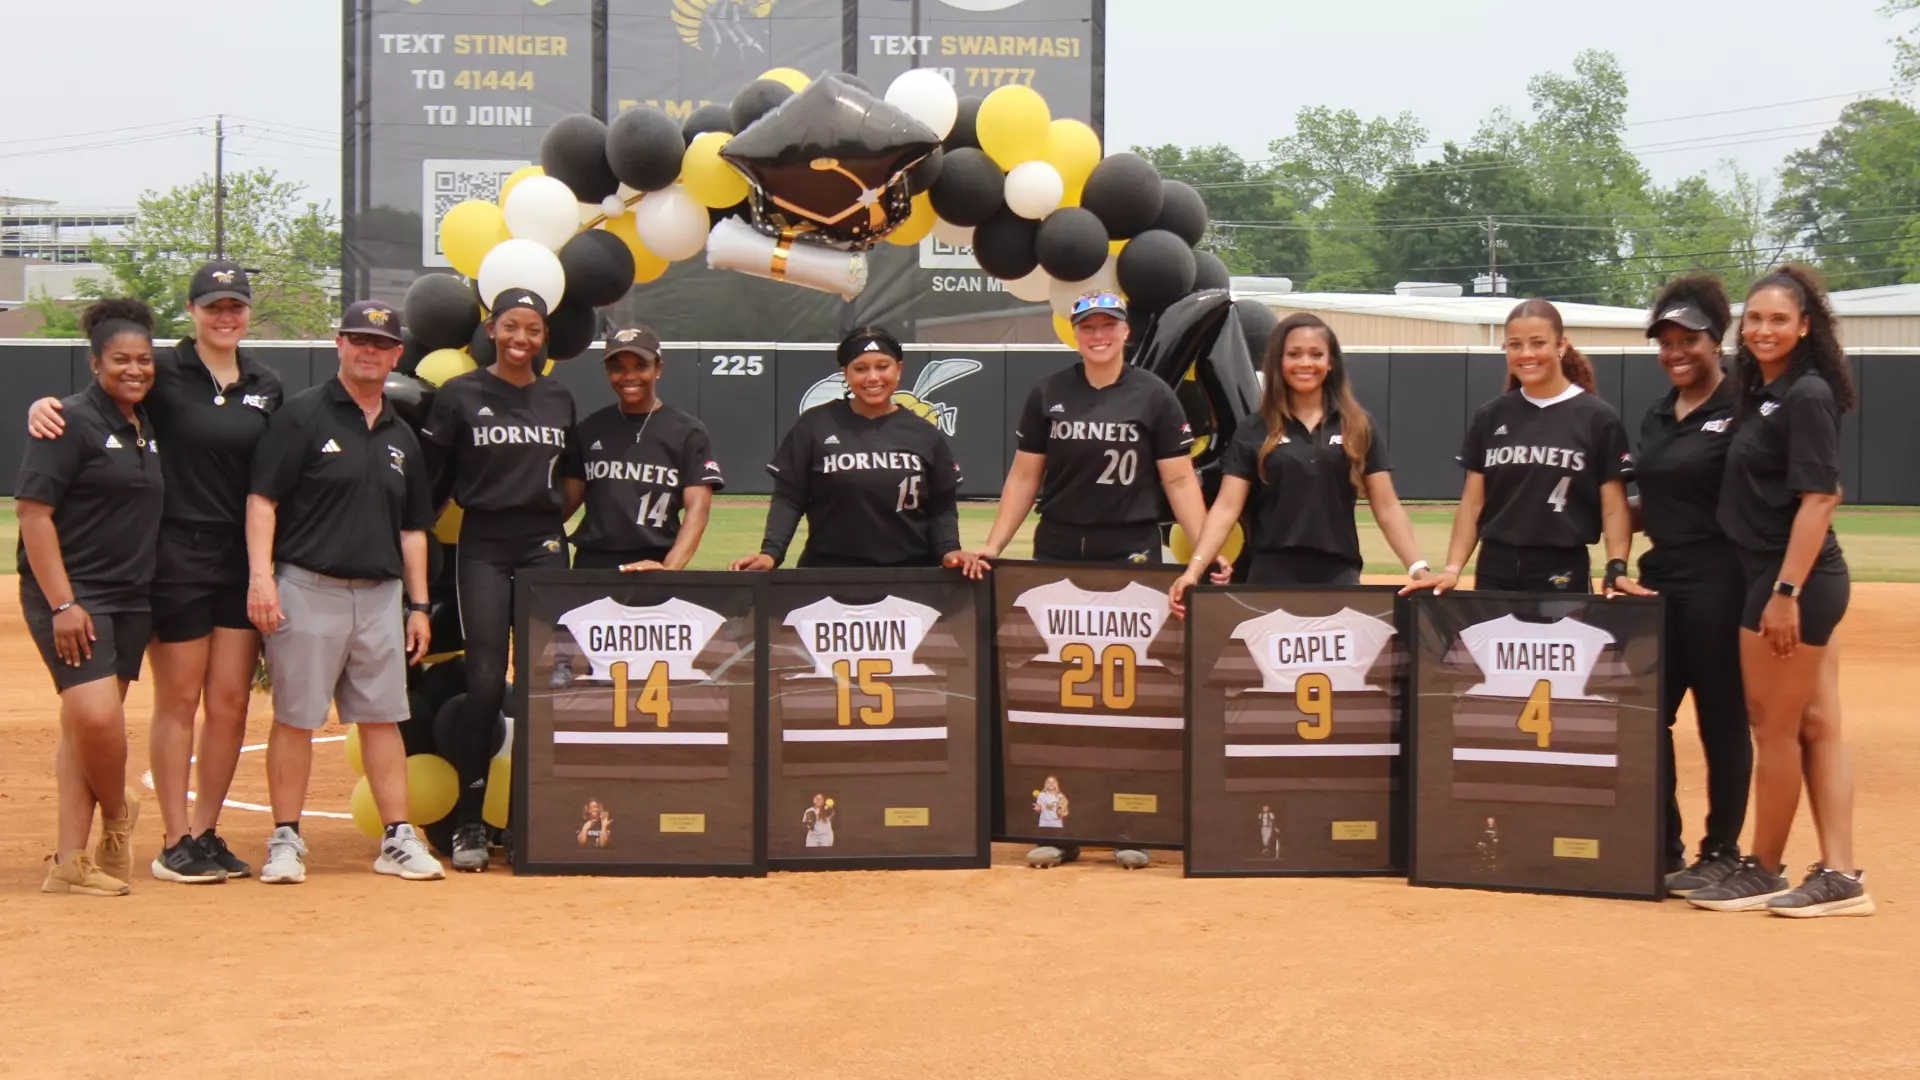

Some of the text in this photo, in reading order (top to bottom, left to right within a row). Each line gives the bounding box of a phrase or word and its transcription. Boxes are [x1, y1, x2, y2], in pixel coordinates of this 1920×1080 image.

[379, 34, 568, 56] TEXT STINGER
[870, 35, 1080, 58] TEXT SWARMAS1
[411, 69, 535, 91] TO 41444
[965, 68, 1036, 88] 71777
[423, 105, 533, 126] TO JOIN!
[932, 276, 981, 292] SCAN
[711, 355, 764, 376] 225
[1049, 420, 1139, 443] HORNETS
[584, 461, 679, 487] HORNETS
[823, 451, 922, 474] HORNETS
[1096, 449, 1139, 486] 20
[1485, 446, 1585, 472] HORNETS
[896, 475, 922, 513] 15
[1547, 476, 1572, 513] 4
[636, 491, 671, 528] 14
[589, 624, 692, 652] GARDNER
[815, 620, 907, 653] BROWN
[1047, 608, 1152, 638] WILLIAMS
[1278, 634, 1347, 665] CAPLE
[1496, 641, 1575, 672] MAHER
[1060, 642, 1136, 709] 20
[610, 660, 673, 728] 14
[832, 658, 895, 726] 15
[1295, 672, 1333, 740] 9
[1516, 678, 1554, 748] 4
